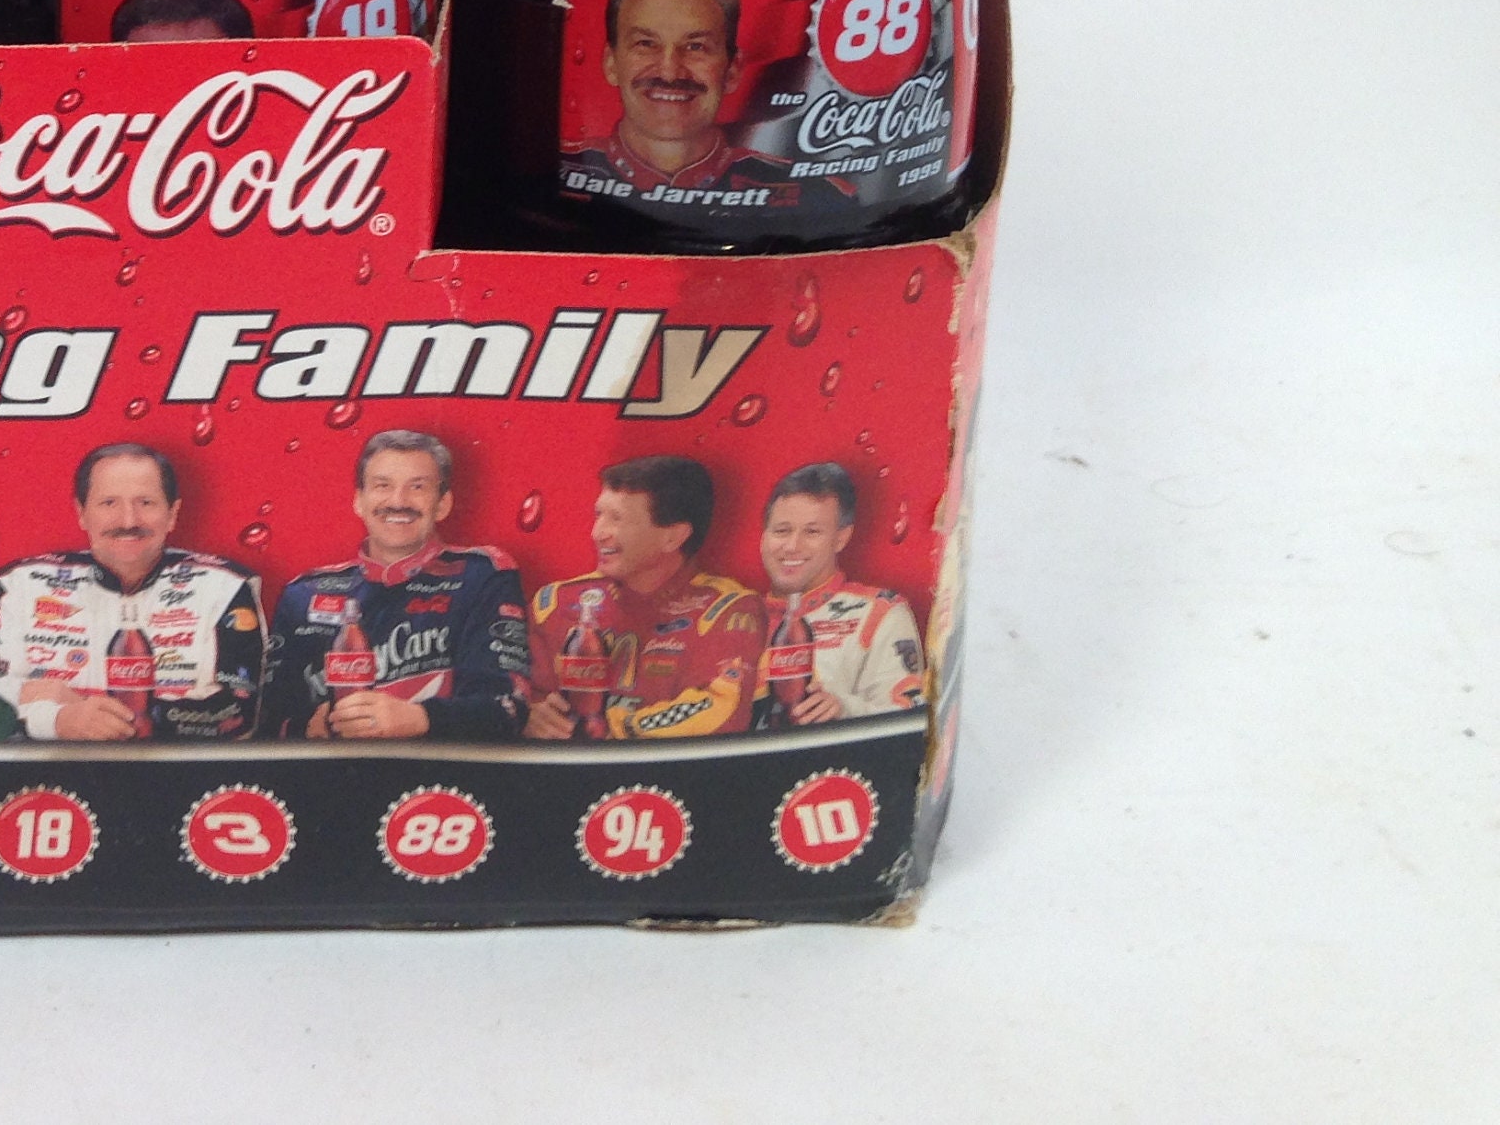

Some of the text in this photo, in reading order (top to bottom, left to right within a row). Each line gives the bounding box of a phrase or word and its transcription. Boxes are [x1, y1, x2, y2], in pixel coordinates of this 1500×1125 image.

[771, 93, 805, 106] the
[797, 70, 945, 154] Coca-Cola
[790, 135, 946, 178] Racing Family
[898, 159, 943, 188] 1999
[566, 171, 771, 207] Dale Jarrett
[162, 309, 771, 420] Family
[15, 808, 74, 859] 18
[203, 812, 272, 854] 3
[396, 813, 478, 856] 88
[602, 805, 665, 863] 94
[793, 798, 861, 848] 10
